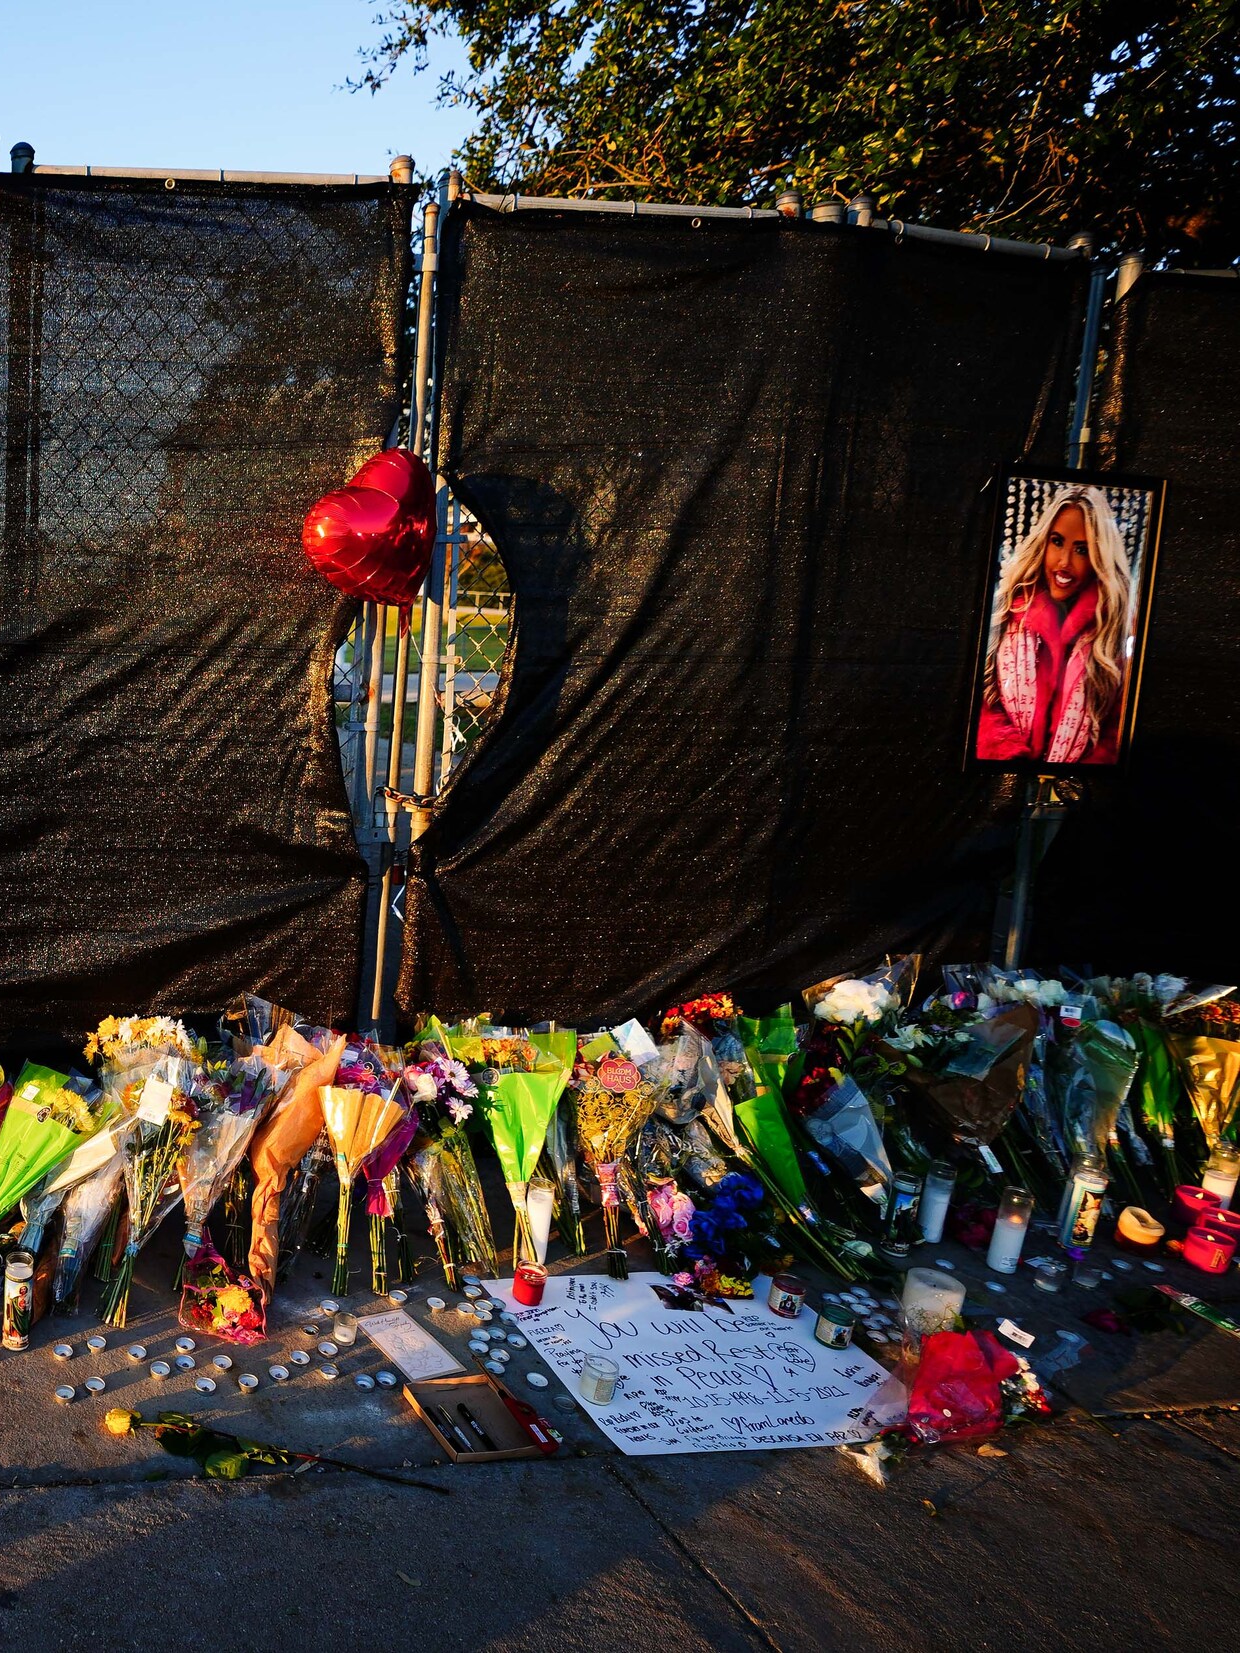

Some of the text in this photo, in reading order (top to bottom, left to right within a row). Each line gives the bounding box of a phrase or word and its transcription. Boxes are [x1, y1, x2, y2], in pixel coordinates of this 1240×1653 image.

[606, 1066, 632, 1076] BLOOM
[607, 1074, 632, 1084] HAUS
[527, 1325, 558, 1337] FUERZA
[564, 1309, 638, 1350] You
[651, 1317, 705, 1335] will
[703, 1312, 758, 1333] be
[702, 1339, 775, 1364] Rest
[650, 1375, 674, 1387] in
[676, 1366, 752, 1390] Peace
[662, 1415, 691, 1427] Dios
[751, 1431, 847, 1444] DESCANSA EN PAZ
